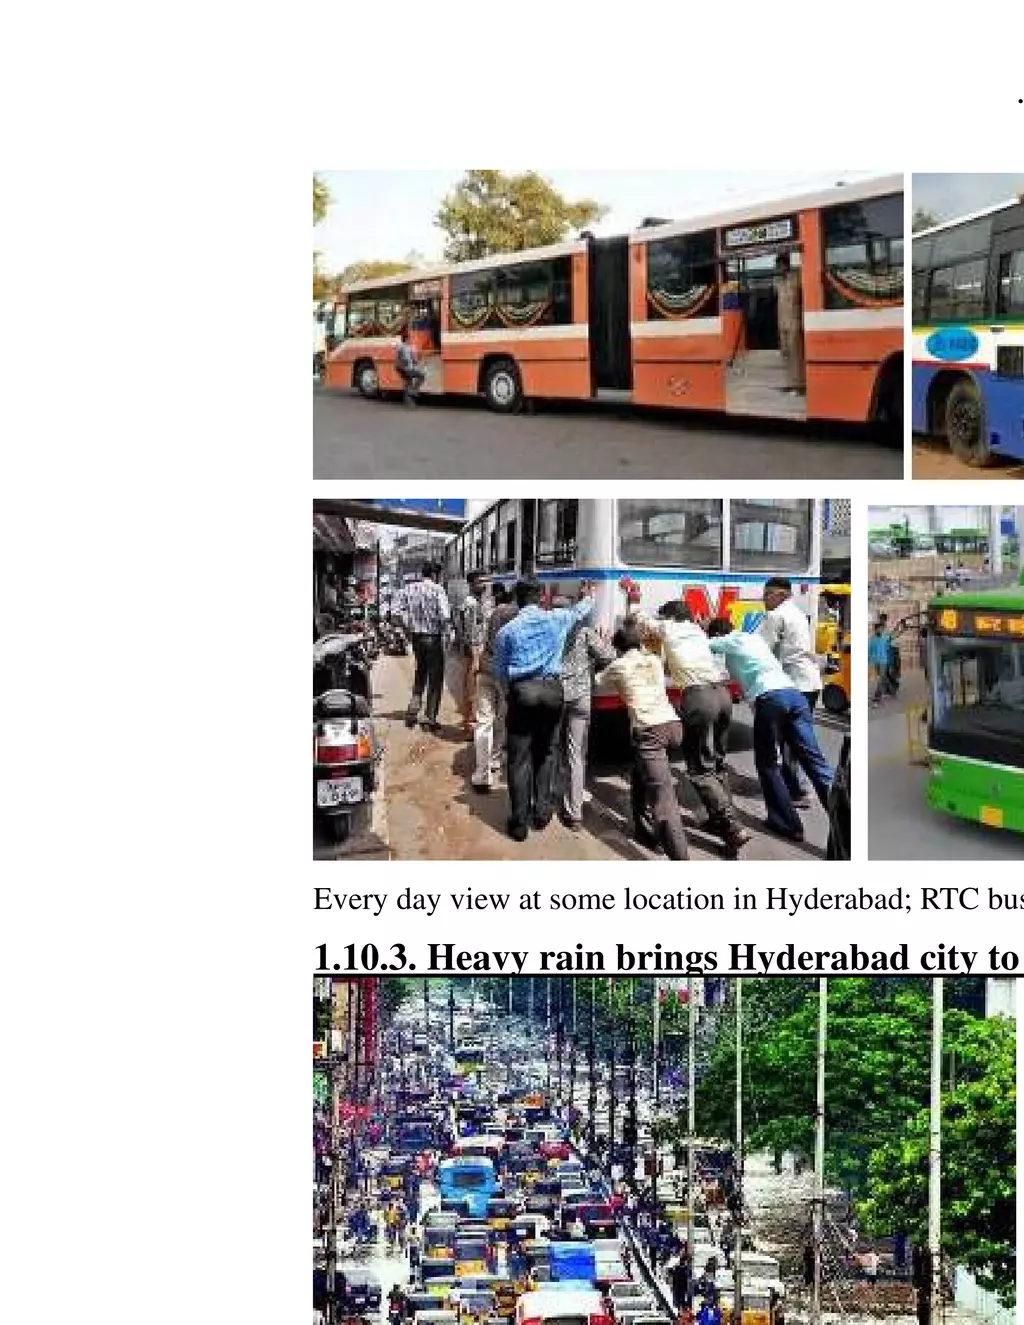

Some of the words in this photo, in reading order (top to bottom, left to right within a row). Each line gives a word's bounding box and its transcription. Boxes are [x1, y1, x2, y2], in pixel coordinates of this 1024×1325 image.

[313, 887, 388, 917] Every
[396, 887, 442, 917] day
[450, 886, 511, 910] view
[519, 890, 542, 910] at
[550, 893, 616, 910] some
[624, 886, 725, 910] location
[733, 886, 758, 910] in
[765, 887, 912, 917] Hyderabad;
[920, 887, 979, 910] RTC
[315, 943, 417, 971] 1.10.3.
[427, 943, 529, 975] Heavy
[539, 942, 606, 971] rain
[615, 943, 718, 975] brings
[727, 943, 910, 975] Hyderabad
[920, 943, 979, 975] city
[988, 945, 1020, 971] to
